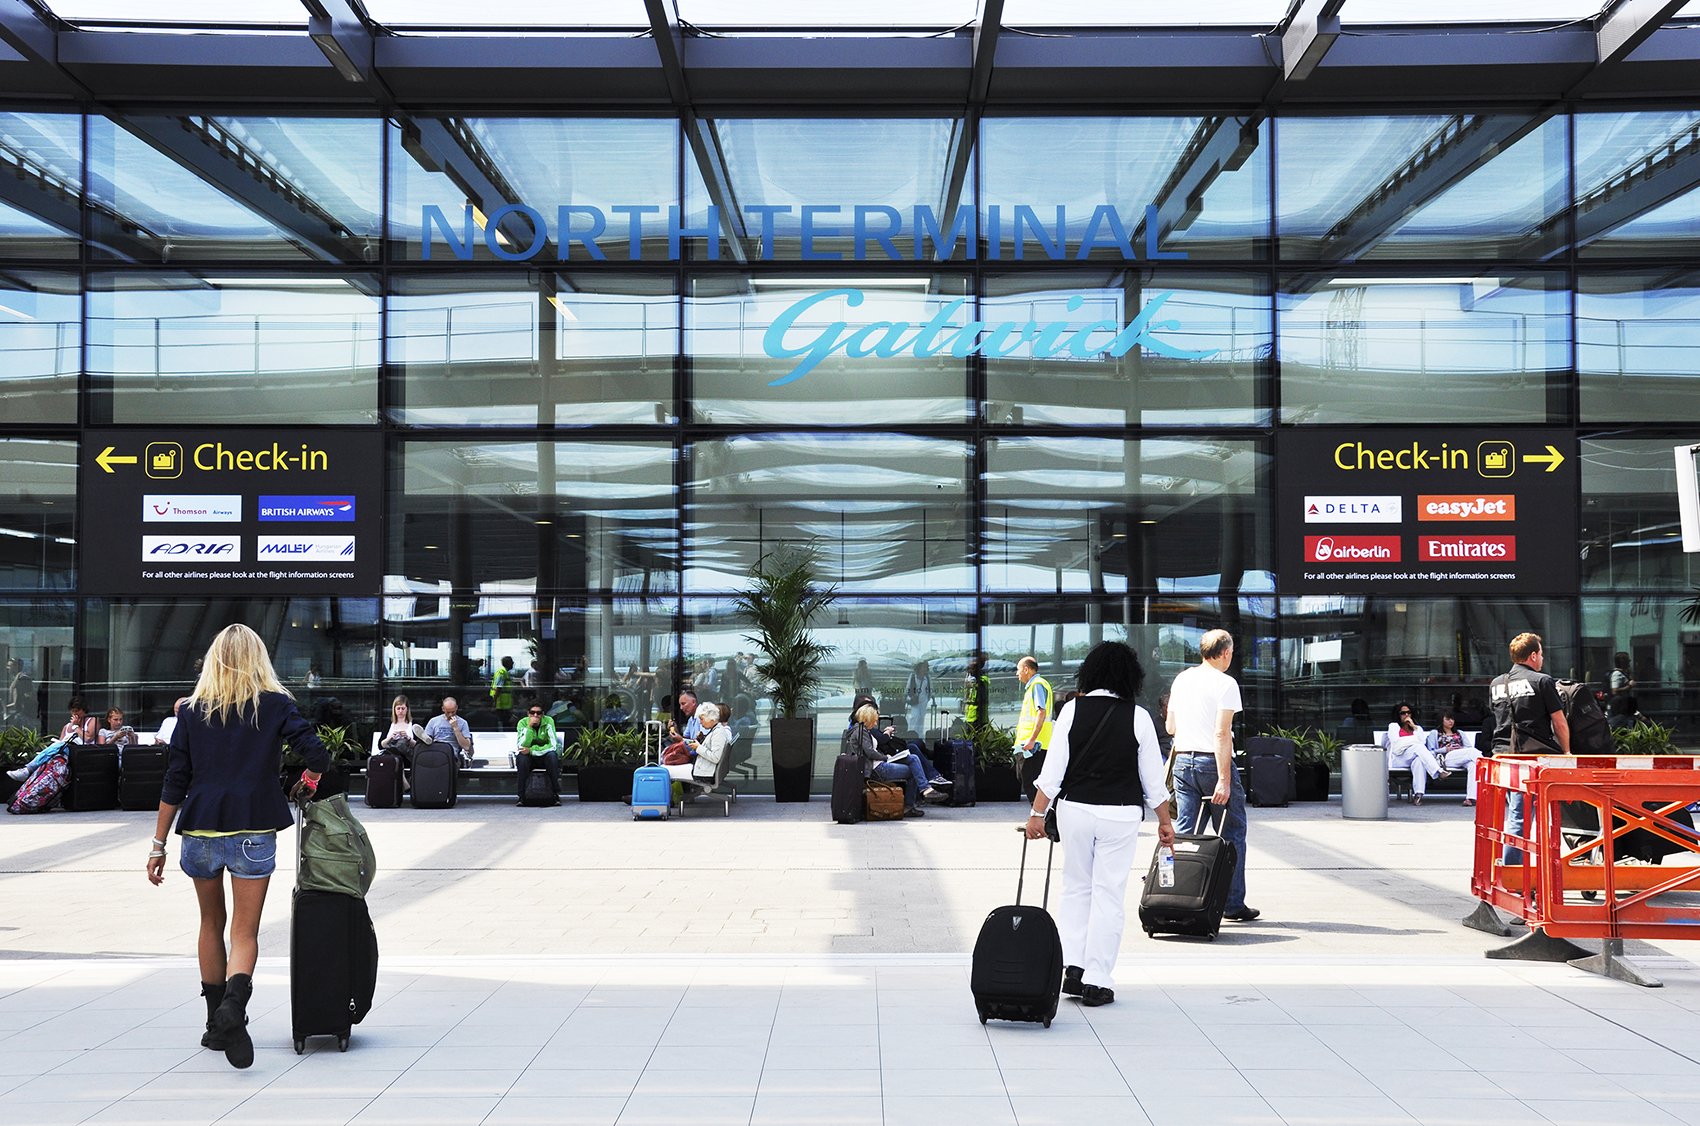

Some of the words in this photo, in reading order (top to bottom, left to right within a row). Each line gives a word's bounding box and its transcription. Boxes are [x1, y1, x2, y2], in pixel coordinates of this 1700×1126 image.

[422, 204, 719, 261] NORTH
[744, 204, 1189, 261] TERMINAL
[763, 288, 1221, 387] Gatwick
[193, 442, 328, 471] Check-in
[1334, 441, 1469, 470] Check-in
[172, 507, 207, 515] Thomson
[261, 508, 296, 516] BRITISH
[296, 508, 335, 517] AIRWAYS
[1325, 503, 1381, 514] DELTA
[1426, 498, 1506, 518] easyJet
[149, 543, 235, 555] ADRIA
[1333, 545, 1391, 559] airberlin
[1428, 539, 1507, 557] Emirates
[142, 571, 154, 579] For
[155, 571, 163, 579] all
[164, 571, 183, 579] other
[184, 571, 208, 579] airlines
[209, 571, 231, 581] please
[232, 571, 247, 579] look
[248, 571, 256, 579] at
[256, 571, 268, 579] the
[269, 571, 287, 581] flight
[288, 571, 328, 579] information
[329, 571, 355, 579] screens
[1304, 572, 1316, 580] For
[1316, 572, 1325, 580] all
[1325, 572, 1344, 580] other
[1345, 572, 1370, 580] airlines
[1370, 572, 1392, 582] please
[1393, 572, 1408, 580] look
[1409, 572, 1417, 580] at
[1417, 572, 1429, 580] the
[1430, 572, 1448, 582] flight
[1449, 572, 1490, 580] information
[1490, 572, 1516, 580] screens
